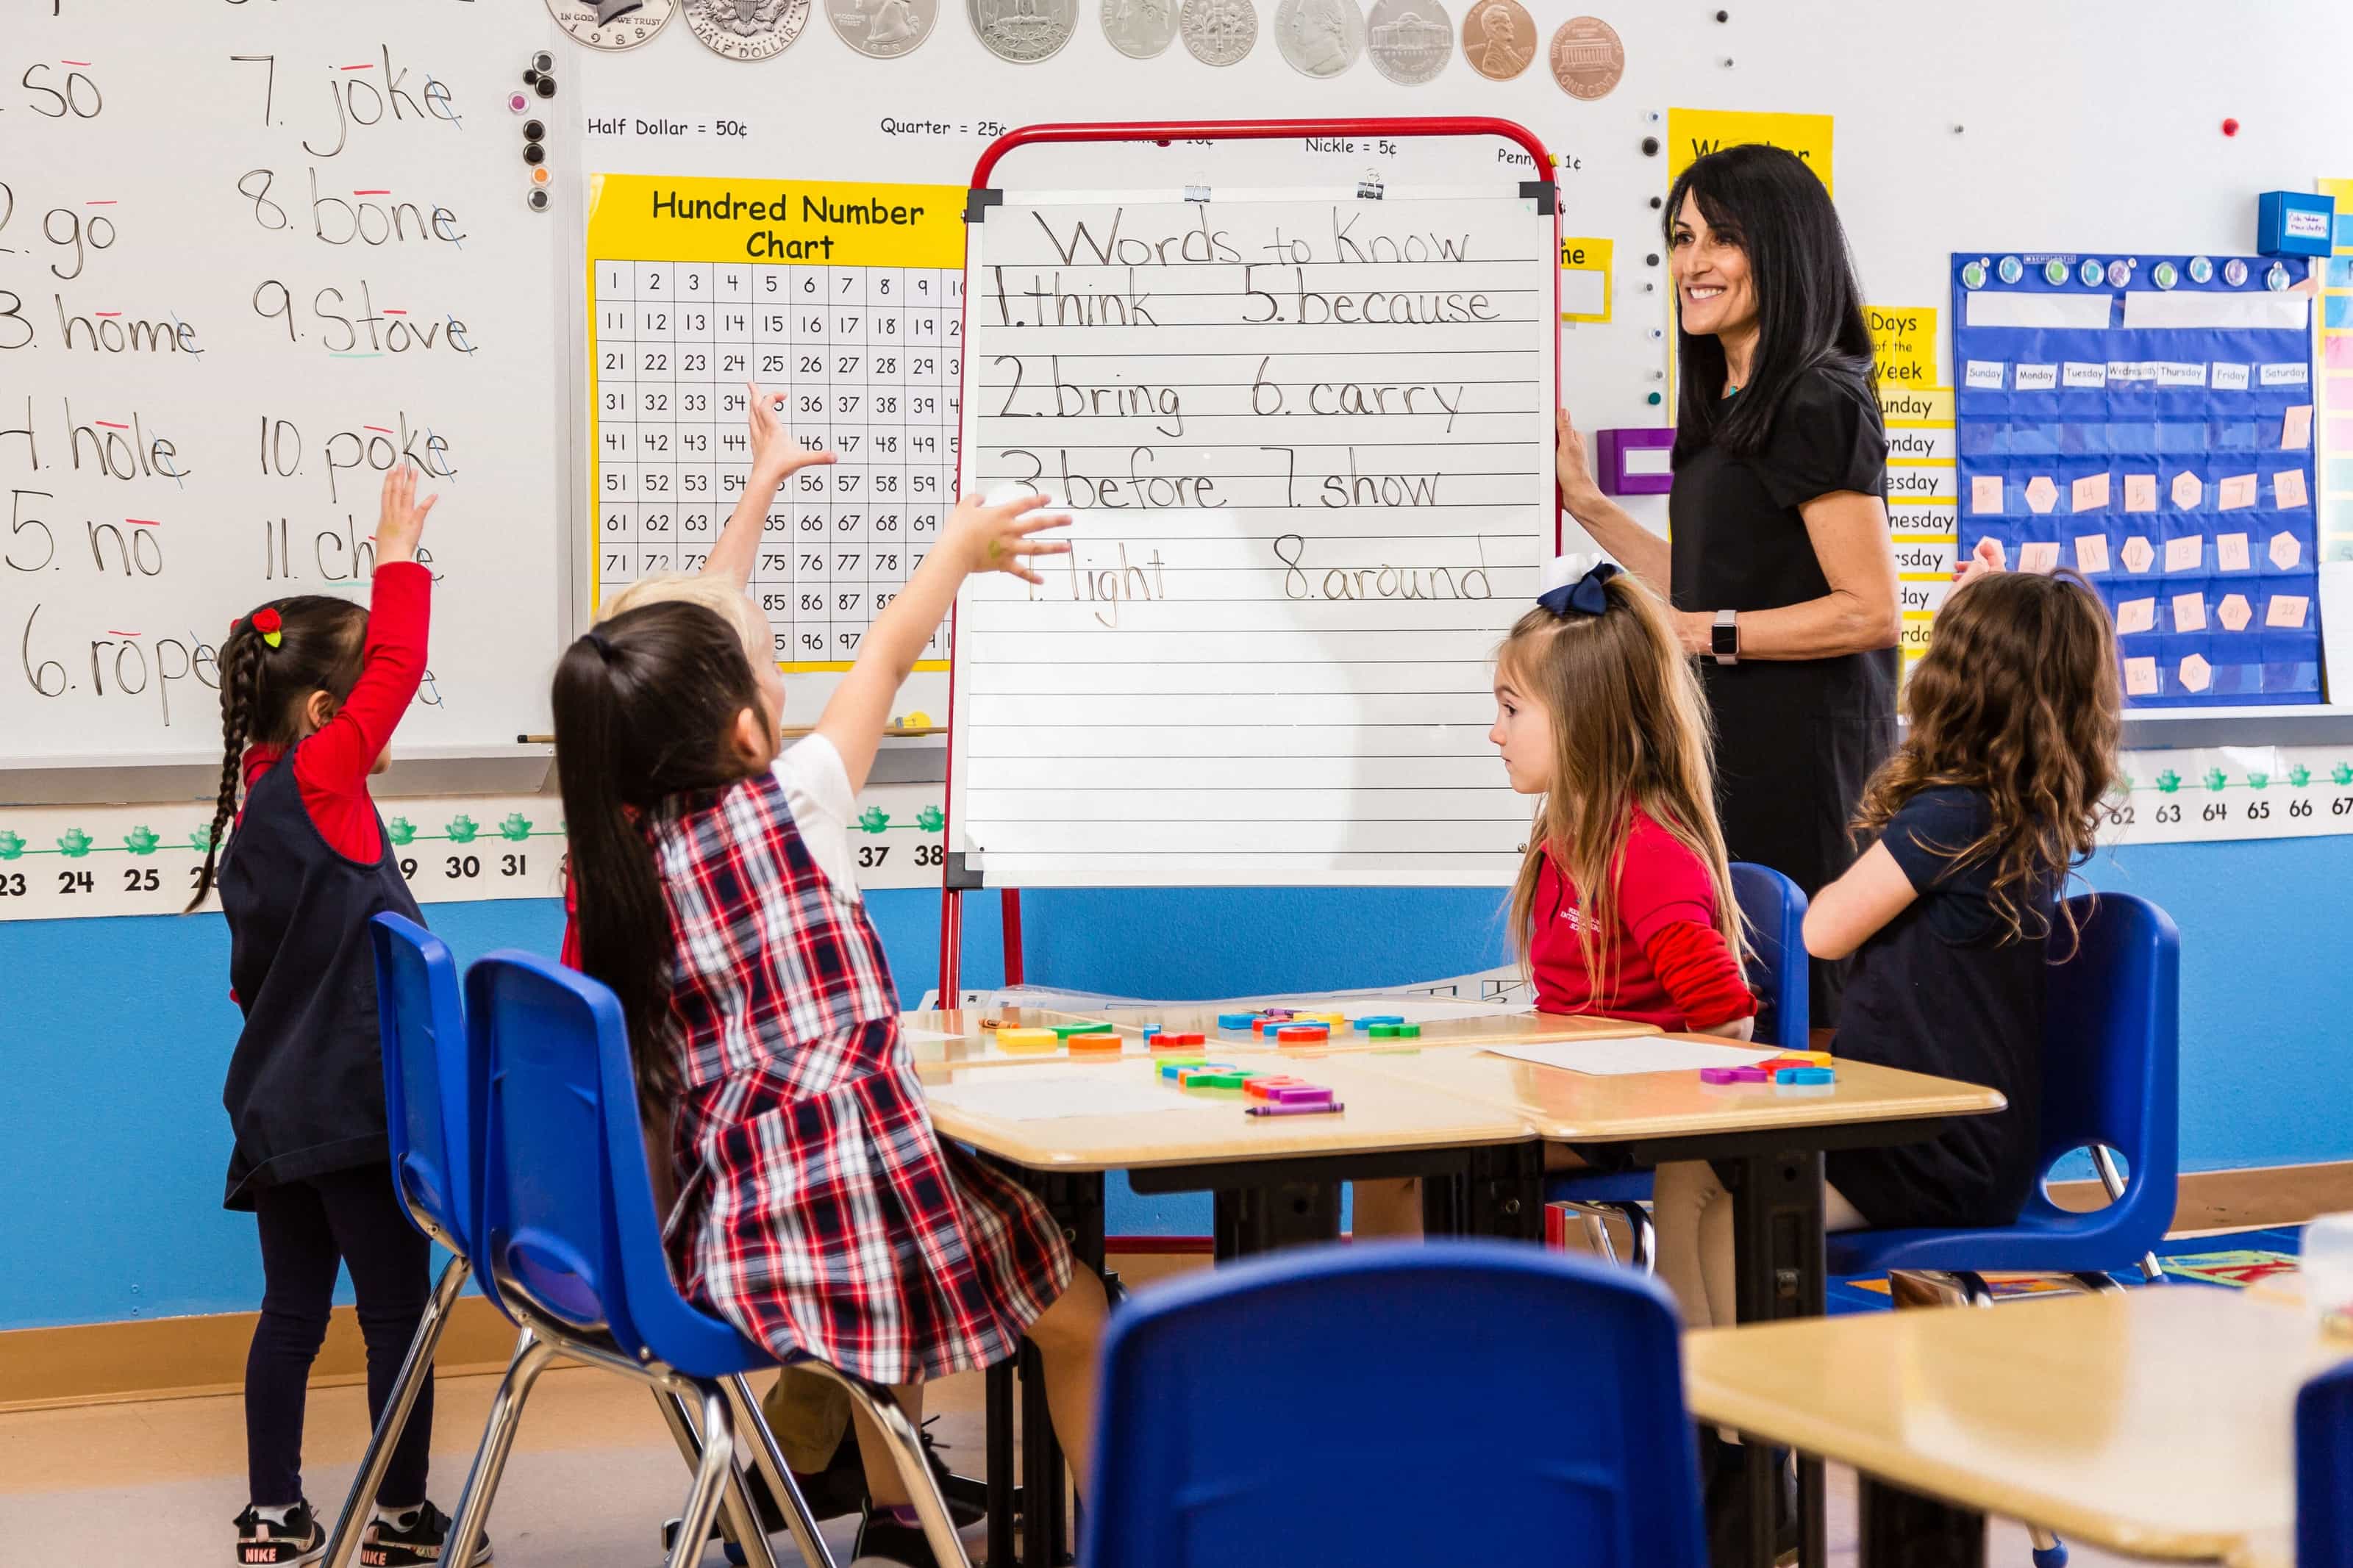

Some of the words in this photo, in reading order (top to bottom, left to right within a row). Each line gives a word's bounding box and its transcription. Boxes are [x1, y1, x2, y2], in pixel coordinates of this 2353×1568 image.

[560, 13, 572, 21] IN
[574, 14, 594, 23] GOD
[616, 16, 632, 24] WE
[632, 17, 662, 26] TRUST
[693, 24, 733, 54] HALF
[738, 26, 799, 59] DOLLAR
[588, 118, 626, 136] Half
[636, 118, 688, 135] Dollar
[715, 120, 748, 139] 50¢
[880, 117, 951, 136] Quarter
[1304, 137, 1354, 154] Nickle
[1378, 140, 1397, 156] 5¢
[1565, 154, 1582, 172] 1¢
[653, 190, 786, 221] Hundred
[802, 195, 924, 226] Number
[746, 230, 835, 259] Chart
[1031, 204, 1241, 267] Words
[1262, 226, 1312, 266] to
[649, 273, 660, 290] 2
[689, 273, 699, 290] 3
[727, 274, 738, 292] 4
[766, 276, 777, 293] 5
[804, 276, 815, 293] 6
[841, 277, 854, 294] 7
[880, 279, 890, 295] 8
[918, 279, 928, 296] 9
[607, 312, 623, 329] 11
[647, 313, 666, 330] 12
[687, 314, 705, 331] 13
[726, 315, 745, 332] 14
[765, 315, 783, 332] 15
[802, 316, 821, 333] 16
[840, 317, 860, 334] 17
[878, 318, 896, 334] 18
[915, 319, 933, 335] 19
[1871, 312, 1917, 337] Days
[1894, 340, 1913, 353] the
[605, 353, 624, 370] 21
[645, 354, 667, 370] 22
[684, 354, 706, 371] 23
[723, 355, 746, 371] 24
[762, 355, 784, 372] 25
[799, 356, 822, 373] 26
[838, 357, 860, 373] 27
[876, 357, 896, 374] 28
[913, 358, 934, 375] 29
[1969, 368, 2002, 382] Sunday
[2019, 370, 2054, 382] Monday
[2065, 368, 2104, 382] Tuesday
[2162, 367, 2202, 378] Thursday
[2217, 369, 2246, 382] Friday
[2265, 368, 2306, 380] Saturday
[606, 393, 624, 410] 31
[645, 394, 668, 411] 32
[685, 394, 706, 411] 33
[724, 395, 746, 412] 34
[800, 395, 823, 412] 36
[838, 396, 860, 412] 37
[876, 397, 897, 413] 38
[913, 397, 934, 414] 39
[1883, 395, 1932, 419] unday
[606, 434, 625, 451] 41
[645, 434, 668, 451] 42
[684, 434, 707, 451] 43
[723, 434, 746, 451] 44
[800, 435, 824, 451] 46
[838, 436, 860, 452] 47
[876, 436, 897, 453] 48
[913, 437, 935, 454] 49
[607, 474, 626, 491] 51
[646, 474, 668, 491] 52
[685, 474, 707, 491] 53
[800, 475, 824, 492] 56
[838, 476, 861, 492] 57
[876, 476, 898, 493] 58
[913, 476, 935, 493] 59
[1885, 471, 1939, 496] esday
[607, 514, 626, 531] 61
[646, 514, 669, 531] 62
[685, 515, 707, 531] 63
[800, 515, 823, 531] 66
[838, 515, 861, 531] 67
[876, 515, 898, 531] 68
[913, 515, 935, 531] 69
[606, 554, 626, 571] 71
[762, 554, 785, 571] 75
[800, 554, 823, 571] 76
[838, 554, 860, 571] 77
[876, 554, 898, 570] 78
[1067, 538, 1165, 629] light
[763, 594, 785, 611] 85
[801, 594, 823, 611] 86
[838, 593, 860, 610] 87
[801, 634, 824, 650] 96
[839, 633, 861, 650] 97
[58, 871, 95, 894] 24
[124, 868, 160, 892] 25
[445, 855, 480, 879] 30
[501, 854, 526, 876] 31
[858, 846, 890, 868] 37
[914, 845, 944, 866] 38
[2155, 804, 2182, 823] 63
[2202, 803, 2227, 822] 64
[2247, 801, 2270, 819] 65
[2289, 799, 2313, 817] 66
[2332, 797, 2353, 815] 67
[245, 1548, 276, 1563] NIKE
[360, 1550, 387, 1566] NIKE
